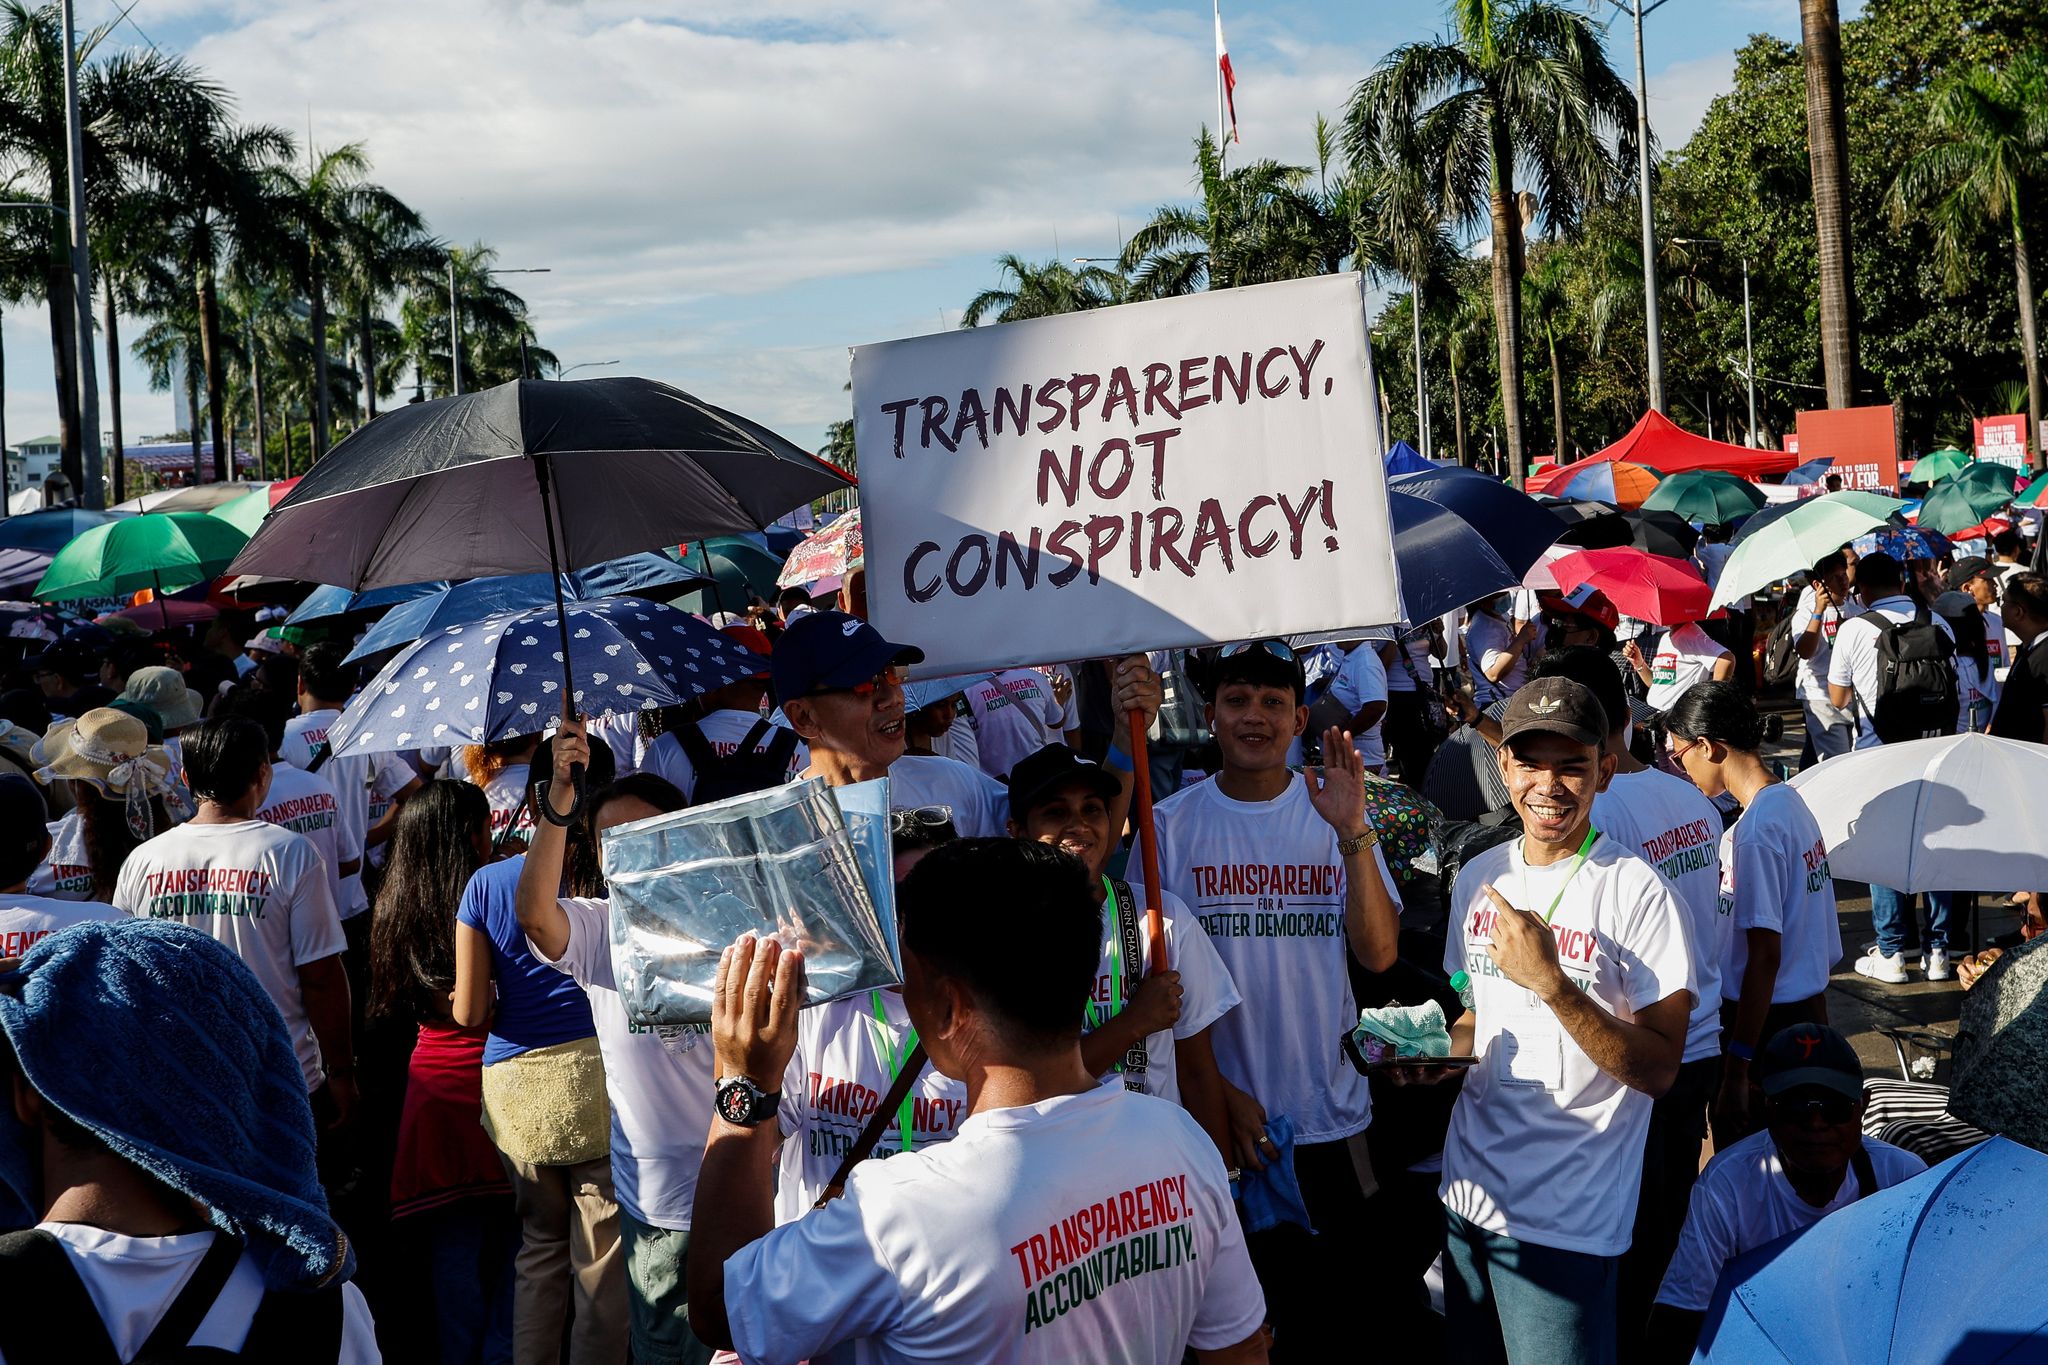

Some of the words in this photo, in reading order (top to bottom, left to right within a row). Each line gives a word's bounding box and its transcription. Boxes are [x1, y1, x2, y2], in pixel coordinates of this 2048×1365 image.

[881, 339, 1333, 459] TRANSPARENCY,
[1036, 427, 1181, 507] NOT
[1856, 471, 1880, 488] FOR
[903, 479, 1340, 604] CONSPIRACY!
[842, 619, 859, 631] NIKE
[146, 868, 272, 897] TRANSPARENCY.
[1191, 863, 1344, 897] TRANSPARENCY
[149, 893, 266, 920] ACCOUNTABILITY.
[1120, 895, 1133, 926] BORN
[1257, 897, 1274, 911] FOR
[1277, 897, 1284, 911] A
[1255, 912, 1345, 938] DEMOCRACY
[1125, 927, 1140, 975] CHAMPS
[1010, 1174, 1194, 1289] TRANSPARENCY.
[1025, 1222, 1197, 1335] ACCOUNTABILITY.
